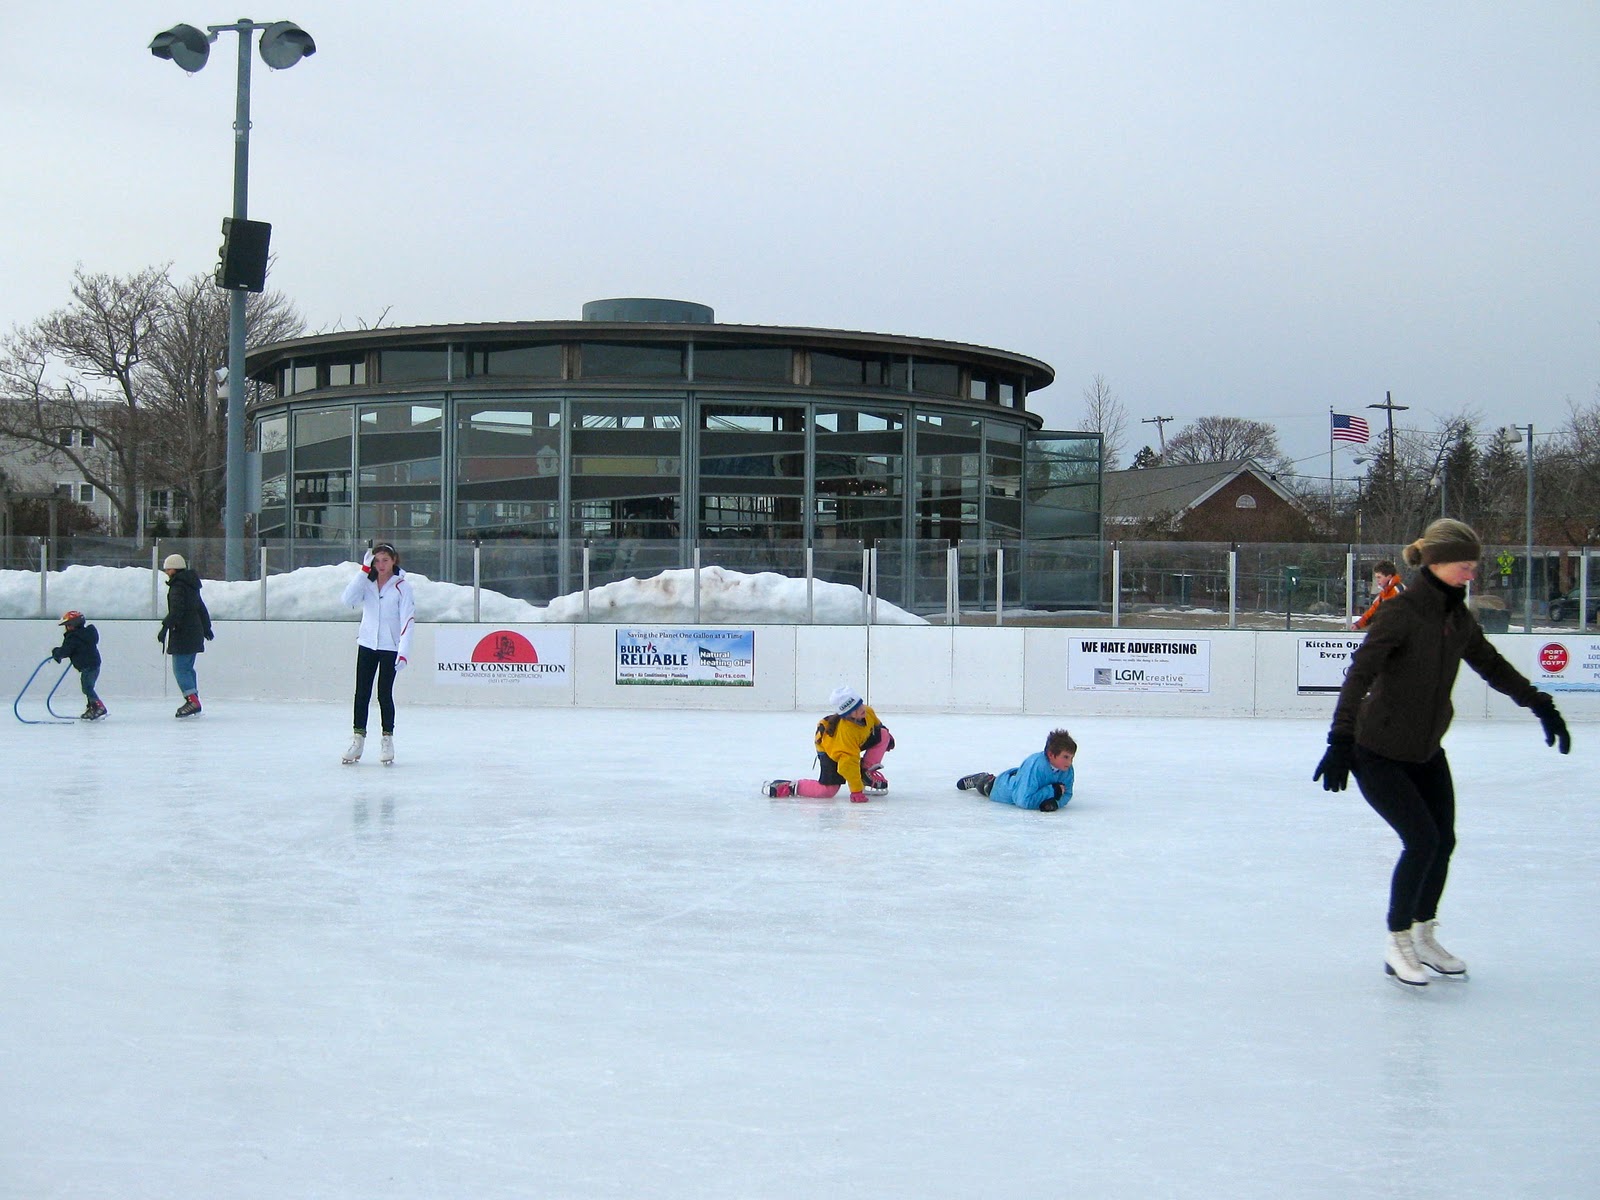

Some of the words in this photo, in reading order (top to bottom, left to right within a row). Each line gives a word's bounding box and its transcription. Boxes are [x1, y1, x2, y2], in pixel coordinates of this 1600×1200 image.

[620, 641, 657, 653] BURT'S
[1081, 641, 1098, 653] WE
[1100, 641, 1126, 653] HATE
[1127, 642, 1197, 655] ADVERTISING
[1305, 640, 1343, 648] Kitchen
[620, 653, 689, 666] RELIABLE
[700, 651, 731, 659] Natural
[1319, 651, 1347, 660] Every
[438, 662, 478, 672] RATSEY
[480, 663, 566, 673] CONSTRUCTION
[700, 659, 732, 668] Heating
